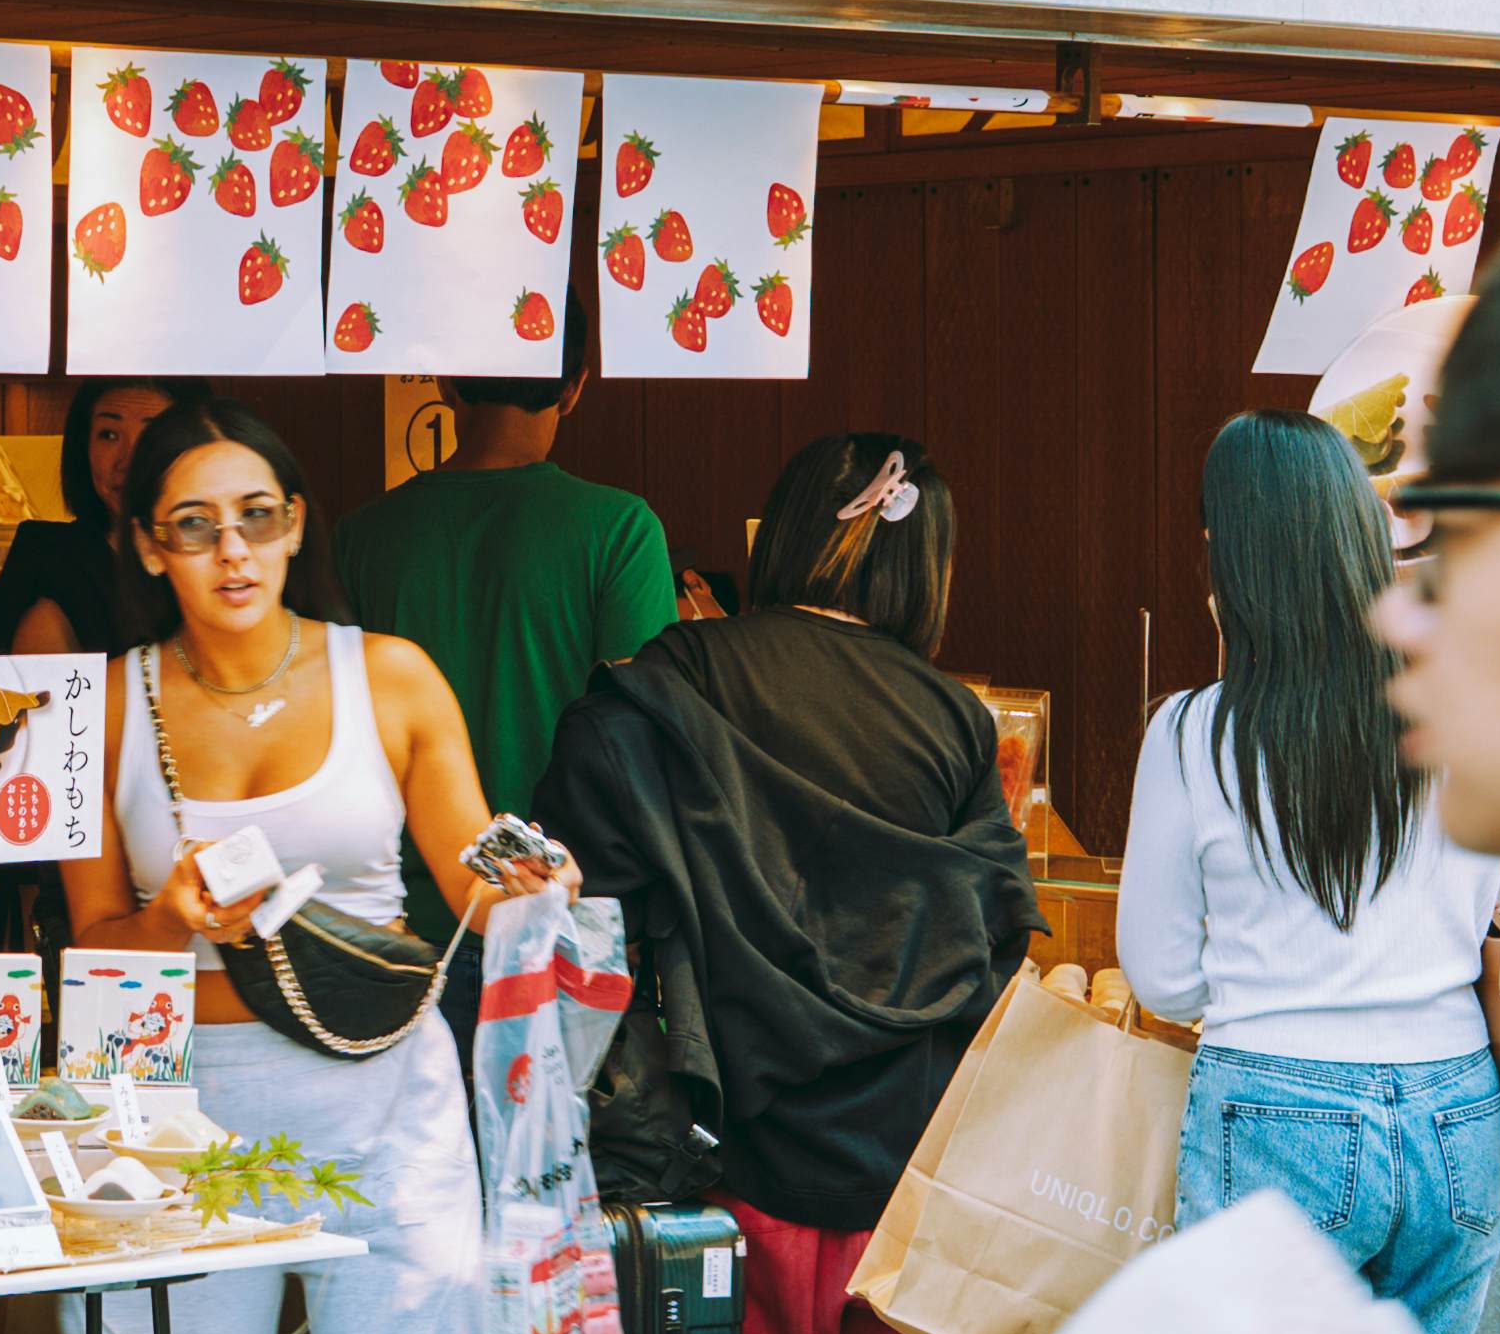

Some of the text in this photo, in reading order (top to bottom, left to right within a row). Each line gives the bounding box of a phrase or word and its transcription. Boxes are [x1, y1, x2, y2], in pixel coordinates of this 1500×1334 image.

[30, 781, 39, 828] もちもち
[63, 669, 91, 848] かしわもち
